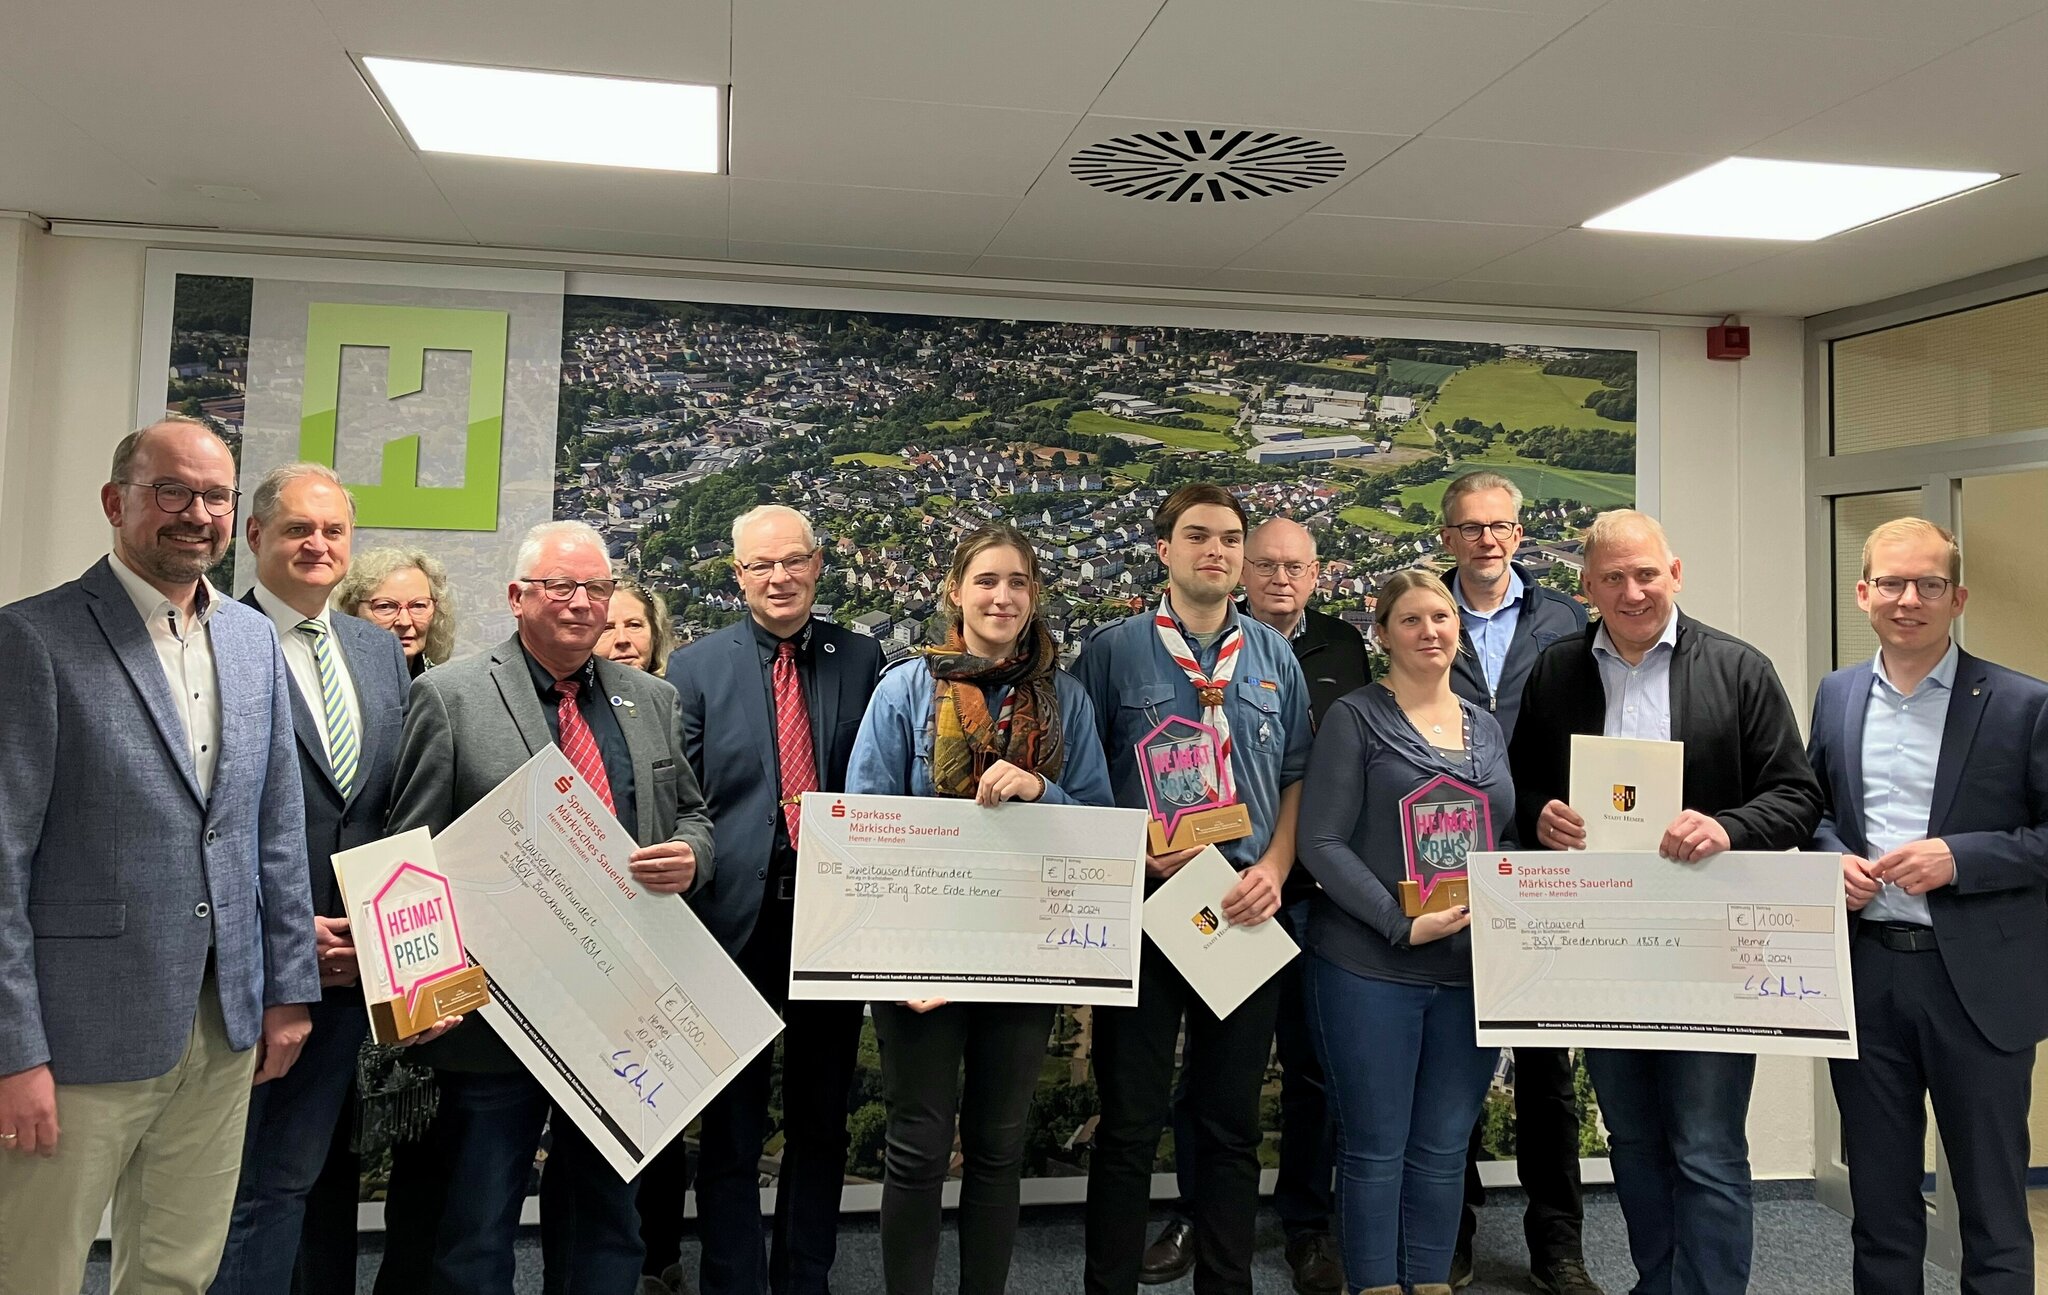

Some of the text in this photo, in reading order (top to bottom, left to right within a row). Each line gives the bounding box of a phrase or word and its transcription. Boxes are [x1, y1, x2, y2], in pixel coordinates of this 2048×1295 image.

[567, 794, 606, 842] Sparkasse
[850, 809, 902, 821] Sparkasse
[499, 808, 524, 836] DE
[850, 823, 960, 837] Märkisches Sauerland
[548, 813, 566, 834] Hemer
[568, 837, 589, 863] Menden
[877, 836, 905, 844] Menden
[555, 804, 637, 900] Märkisches Sauerland
[818, 862, 843, 875] DE
[1048, 866, 1058, 878] €
[1518, 866, 1570, 877] Sparkasse
[1519, 878, 1633, 888] Märkisches Sauerland
[915, 883, 938, 895] Rote
[943, 885, 965, 896] Erde
[969, 887, 1002, 897] Hemer
[1048, 886, 1076, 897] Hemer
[512, 854, 535, 879] MGV
[532, 879, 578, 935] Brockhausen
[580, 936, 601, 959] 1891
[387, 897, 444, 937] HEIMAT
[1736, 914, 1749, 926] €
[1491, 918, 1516, 929] DE
[1527, 919, 1585, 929] eintausend
[1531, 935, 1555, 946] BSV
[1560, 936, 1628, 946] Bredenbruch
[1636, 936, 1660, 947] 1858
[1738, 936, 1770, 946] Hemer
[394, 932, 439, 968] PREIS
[664, 999, 677, 1012] €
